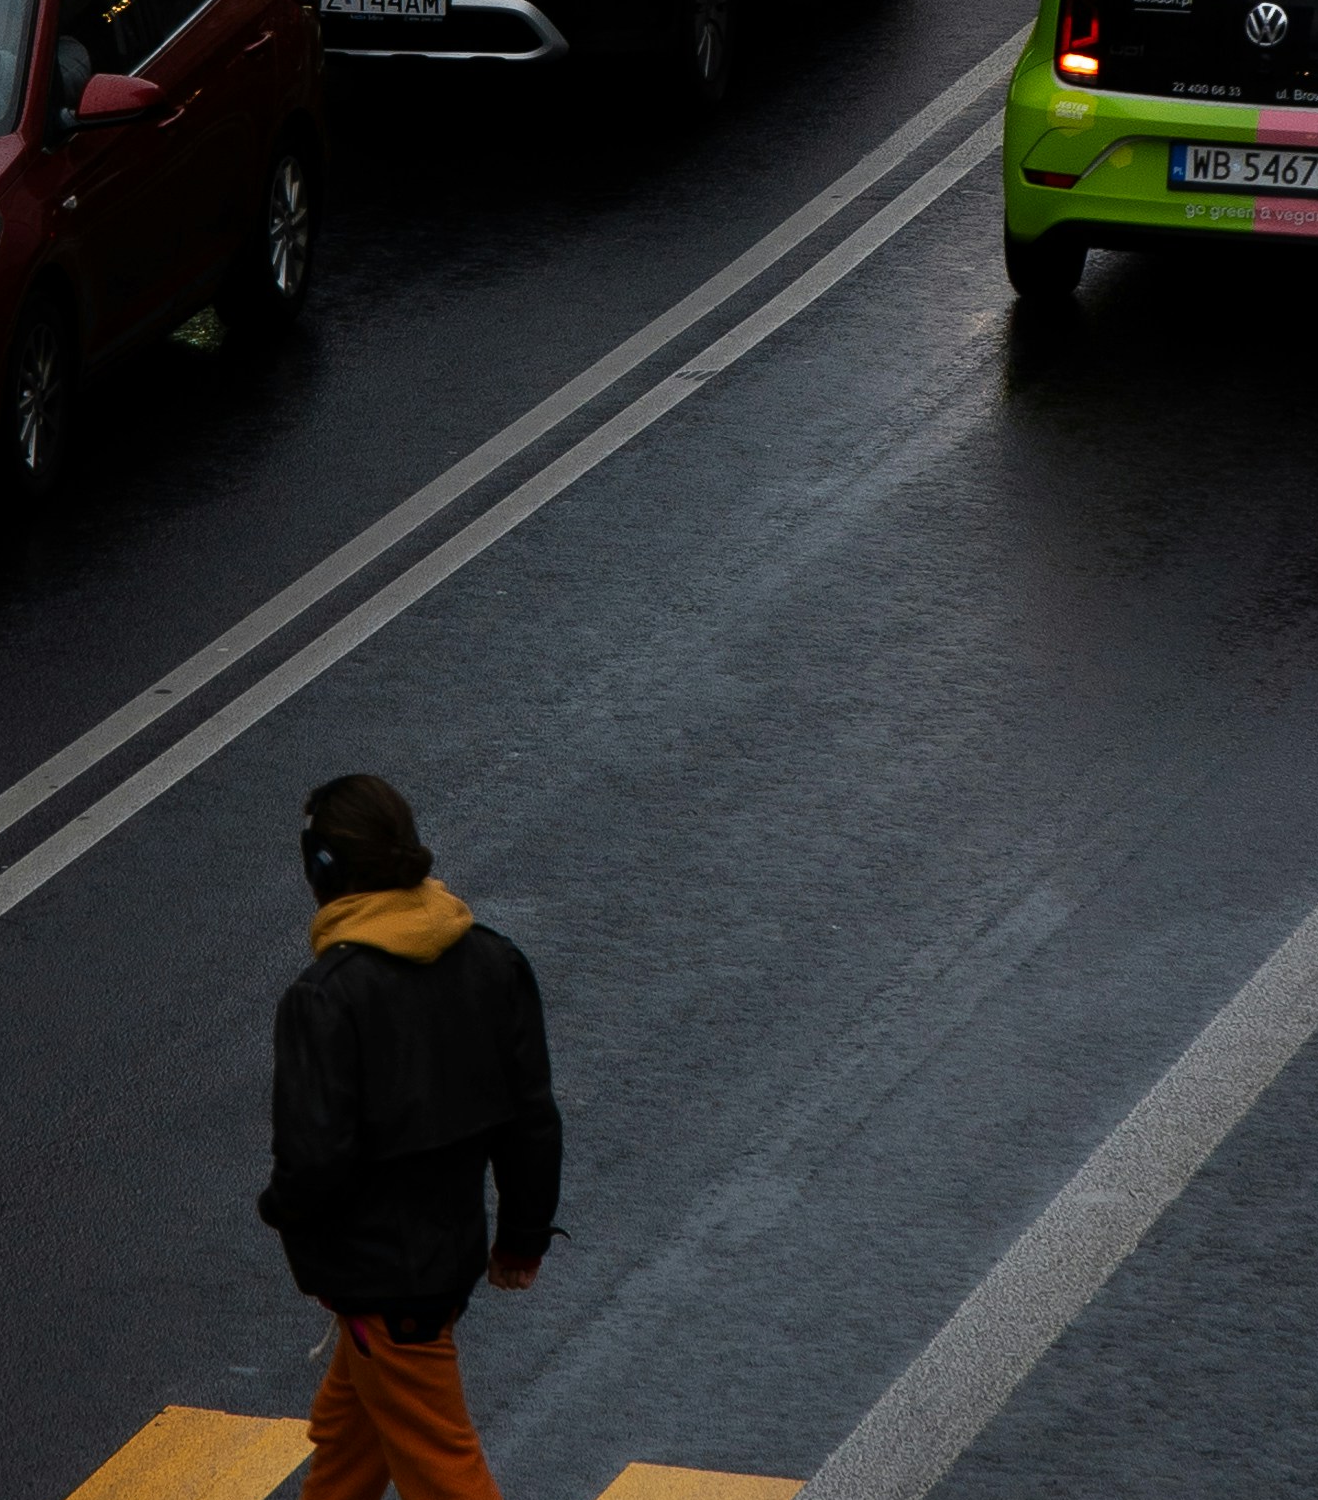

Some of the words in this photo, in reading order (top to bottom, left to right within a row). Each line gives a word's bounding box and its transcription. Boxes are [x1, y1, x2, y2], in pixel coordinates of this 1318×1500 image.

[1171, 81, 1185, 93] 22
[1188, 83, 1209, 95] 400
[1211, 84, 1226, 96] 66
[1228, 85, 1242, 97] 33
[1275, 88, 1288, 100] ul.
[1193, 149, 1230, 180] WB
[1184, 203, 1205, 218] go
[1211, 205, 1255, 220] green
